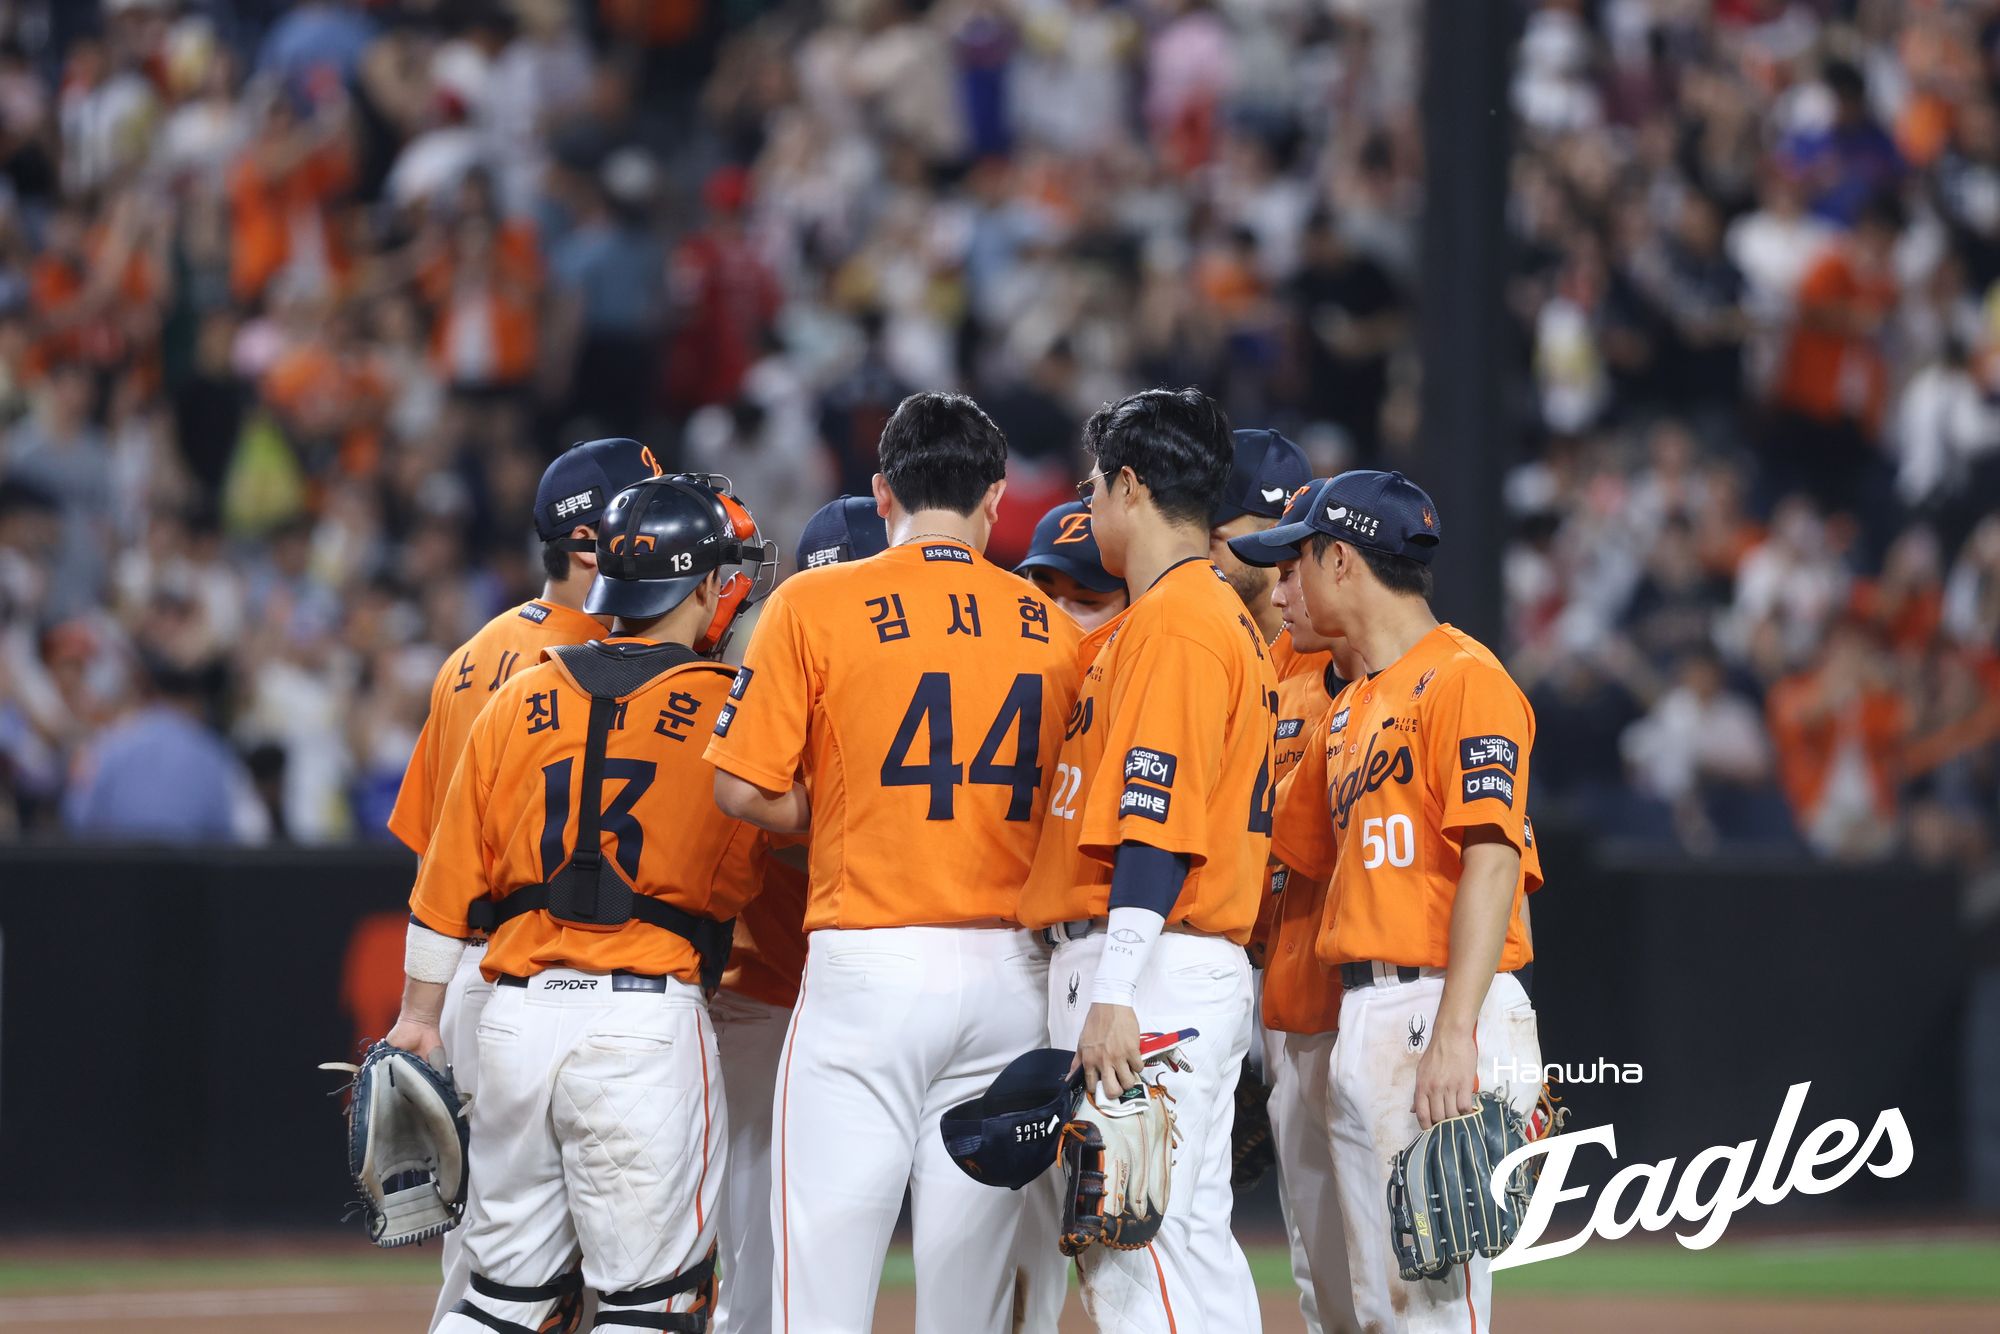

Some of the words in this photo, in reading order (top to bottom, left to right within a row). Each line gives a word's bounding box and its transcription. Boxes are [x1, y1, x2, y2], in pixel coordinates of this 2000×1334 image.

[555, 490, 592, 518] 부루펜
[1345, 519, 1376, 537] PLUS
[1349, 510, 1380, 529] LIFE
[670, 552, 693, 572] 13
[925, 549, 952, 558] 모두의
[952, 550, 971, 561] 안과
[1394, 725, 1417, 733] PLUS
[880, 672, 1043, 821] 44
[1480, 738, 1509, 747] Nucare
[1469, 745, 1514, 769] 뉴케어
[1125, 757, 1169, 783] 뉴케어
[1051, 762, 1082, 820] 22
[1482, 775, 1513, 800] 알바몬
[1126, 790, 1166, 814] 알바몬
[540, 756, 658, 884] 13
[1363, 814, 1415, 870] 50
[544, 979, 598, 991] SPYDER
[1016, 1121, 1046, 1134] PLUS
[1016, 1130, 1046, 1142] LIFE
